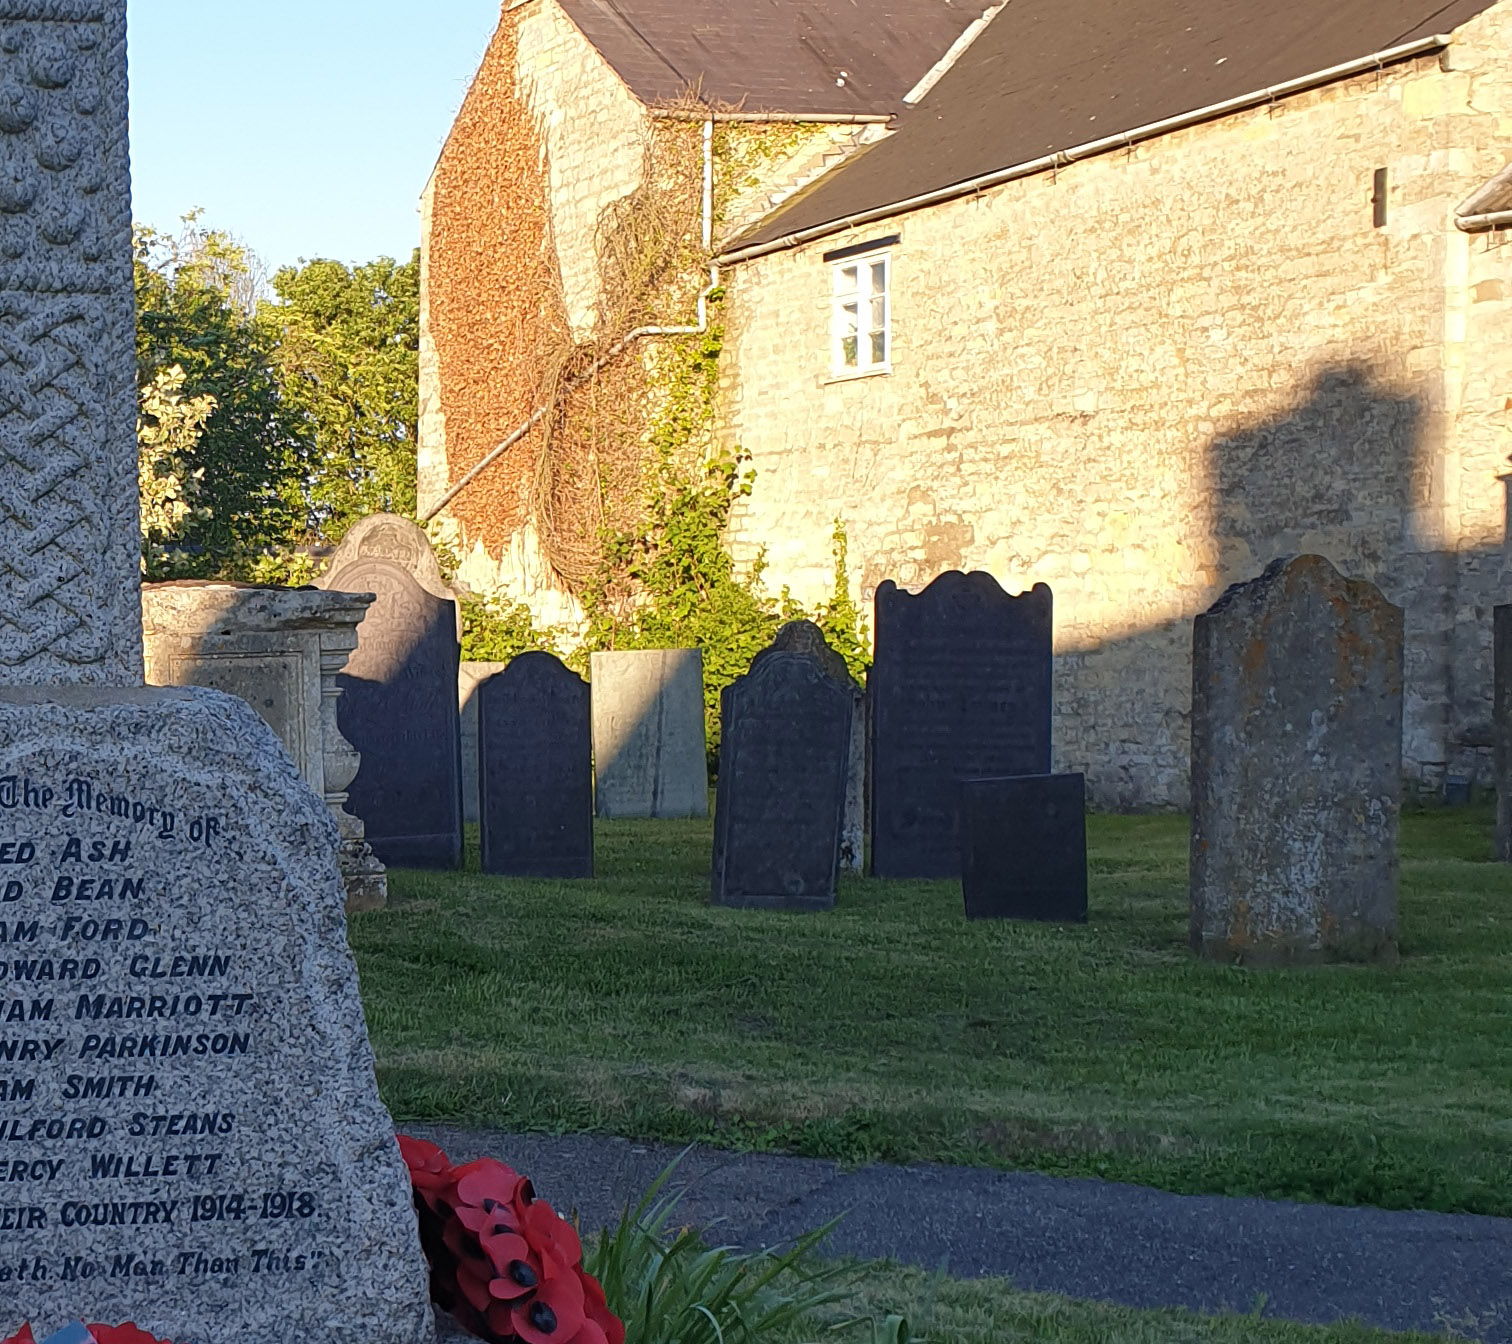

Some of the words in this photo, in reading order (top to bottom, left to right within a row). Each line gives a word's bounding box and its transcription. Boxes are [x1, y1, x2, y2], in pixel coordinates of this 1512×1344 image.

[62, 777, 176, 840] Memory
[190, 816, 220, 848] of
[59, 837, 131, 863] ASH
[51, 875, 145, 901] BEAN
[60, 916, 150, 942] FORD
[129, 954, 230, 978] GLENN
[75, 993, 254, 1020] MARRIOTT
[78, 1033, 251, 1060] PARKINSON
[62, 1074, 155, 1099] SMITH
[128, 1112, 236, 1137] STEANS
[89, 1154, 223, 1179] WILLETT
[60, 1199, 179, 1227] COUNTRY
[60, 1256, 96, 1282] No
[110, 1254, 165, 1278] Man
[177, 1251, 239, 1275] Than
